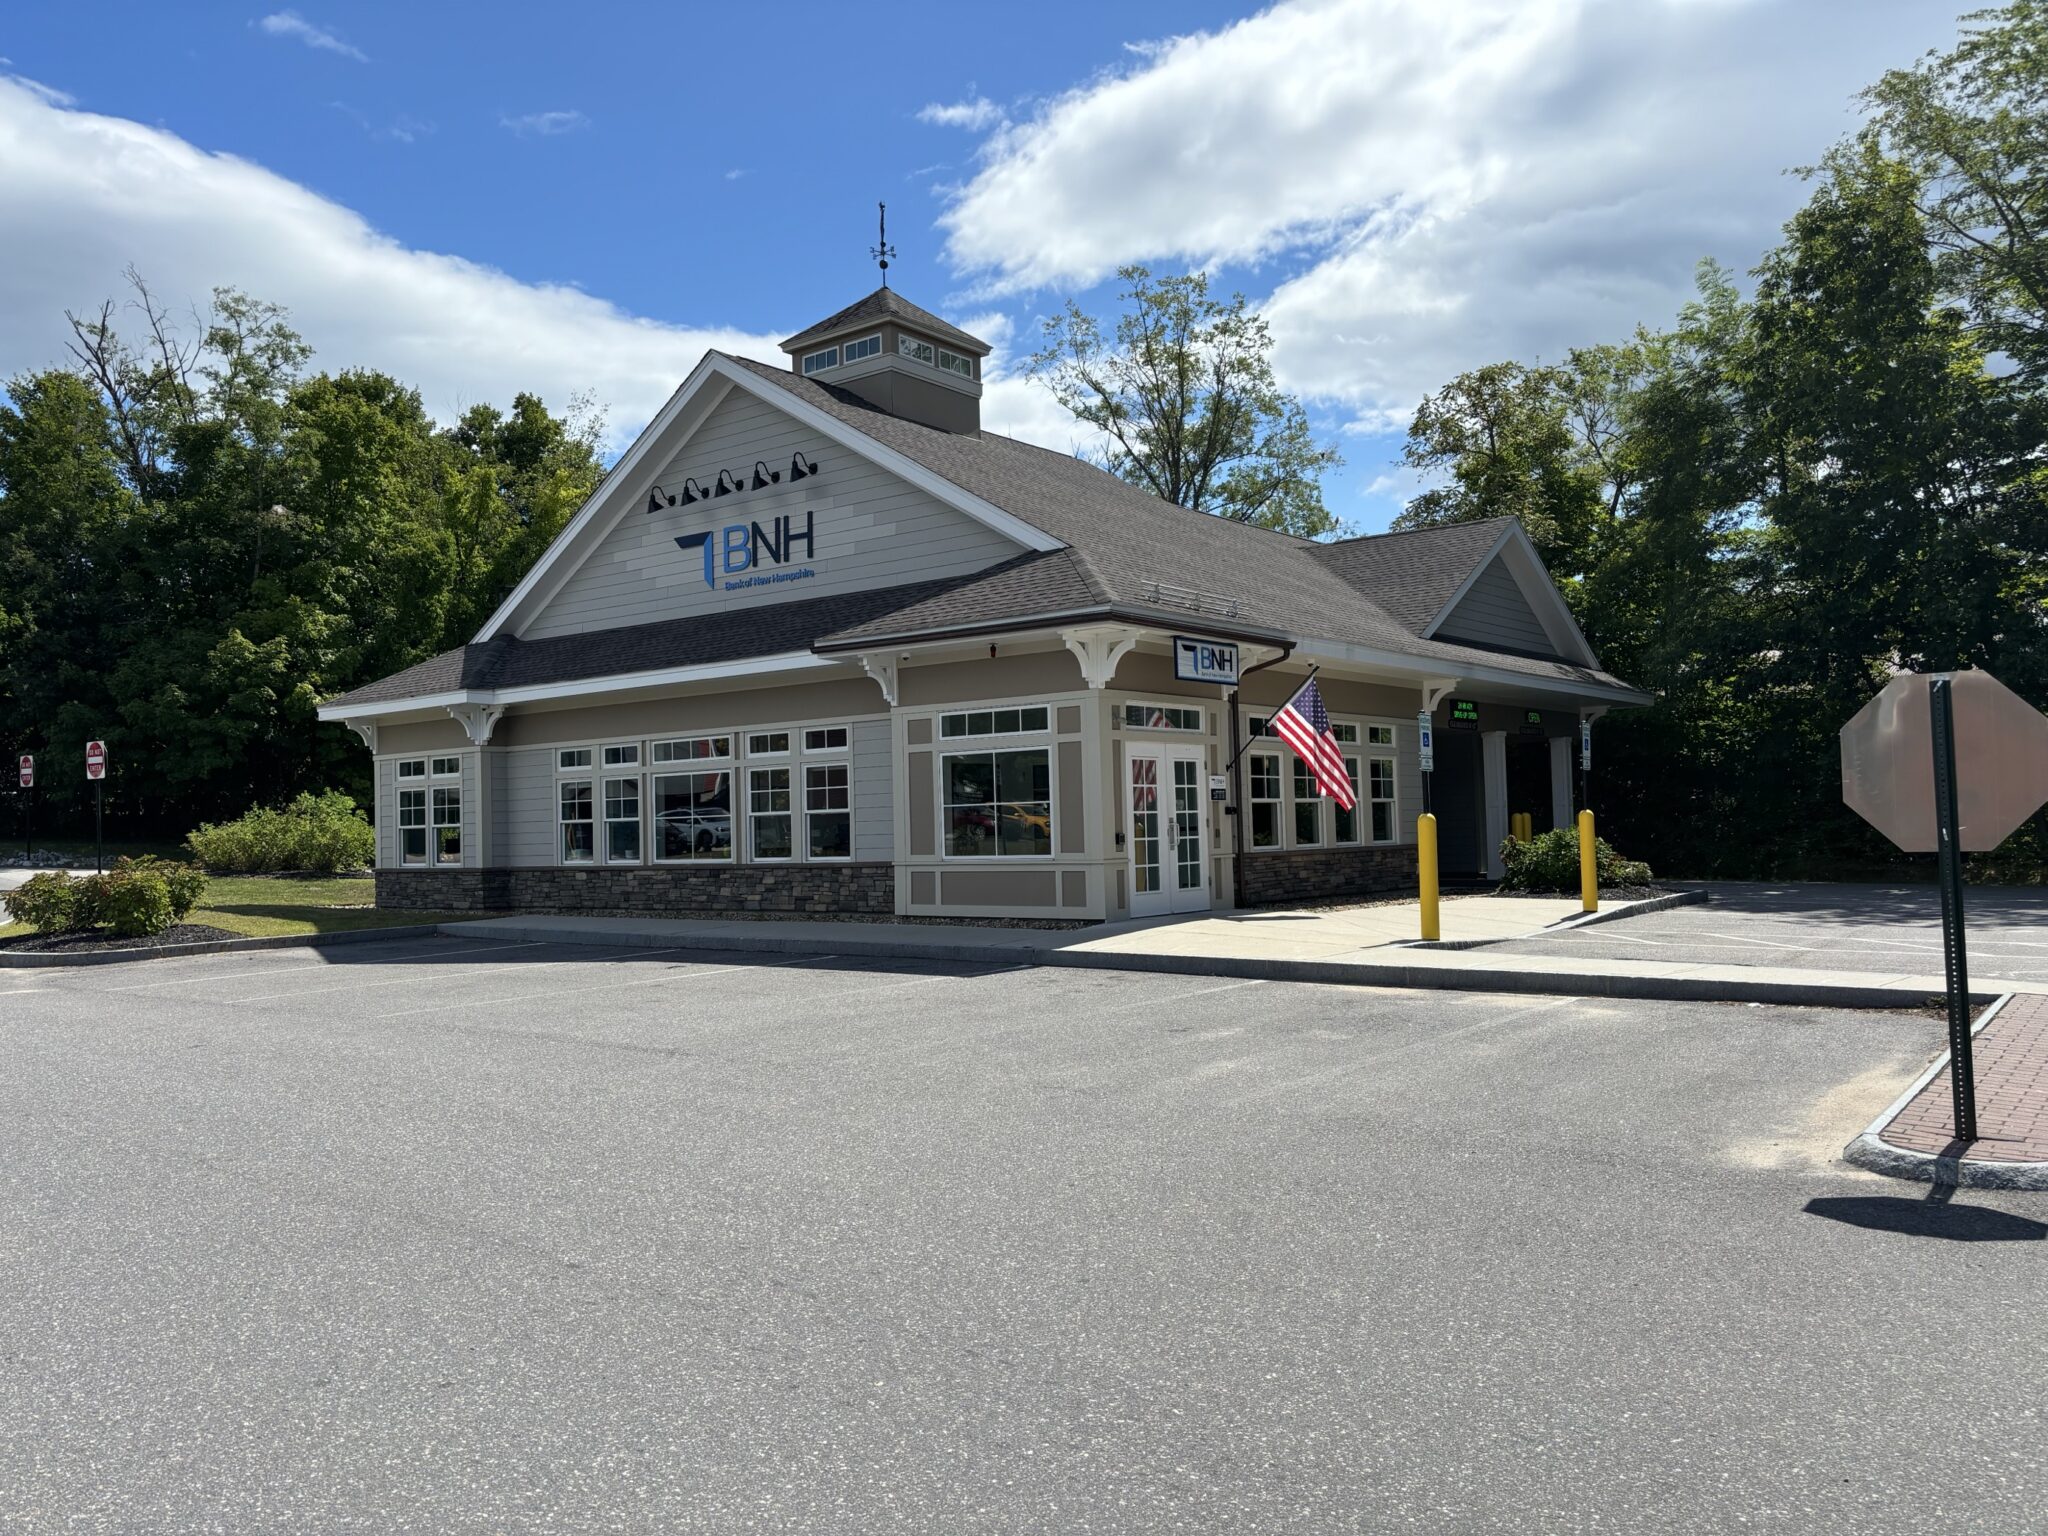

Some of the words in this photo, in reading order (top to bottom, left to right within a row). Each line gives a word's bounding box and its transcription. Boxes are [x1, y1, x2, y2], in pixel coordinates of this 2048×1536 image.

[723, 511, 814, 573] BNH
[725, 579, 745, 591] Bank
[745, 577, 752, 588] of
[753, 575, 771, 587] New
[772, 568, 815, 584] Hampshire
[1201, 647, 1233, 672] BNH
